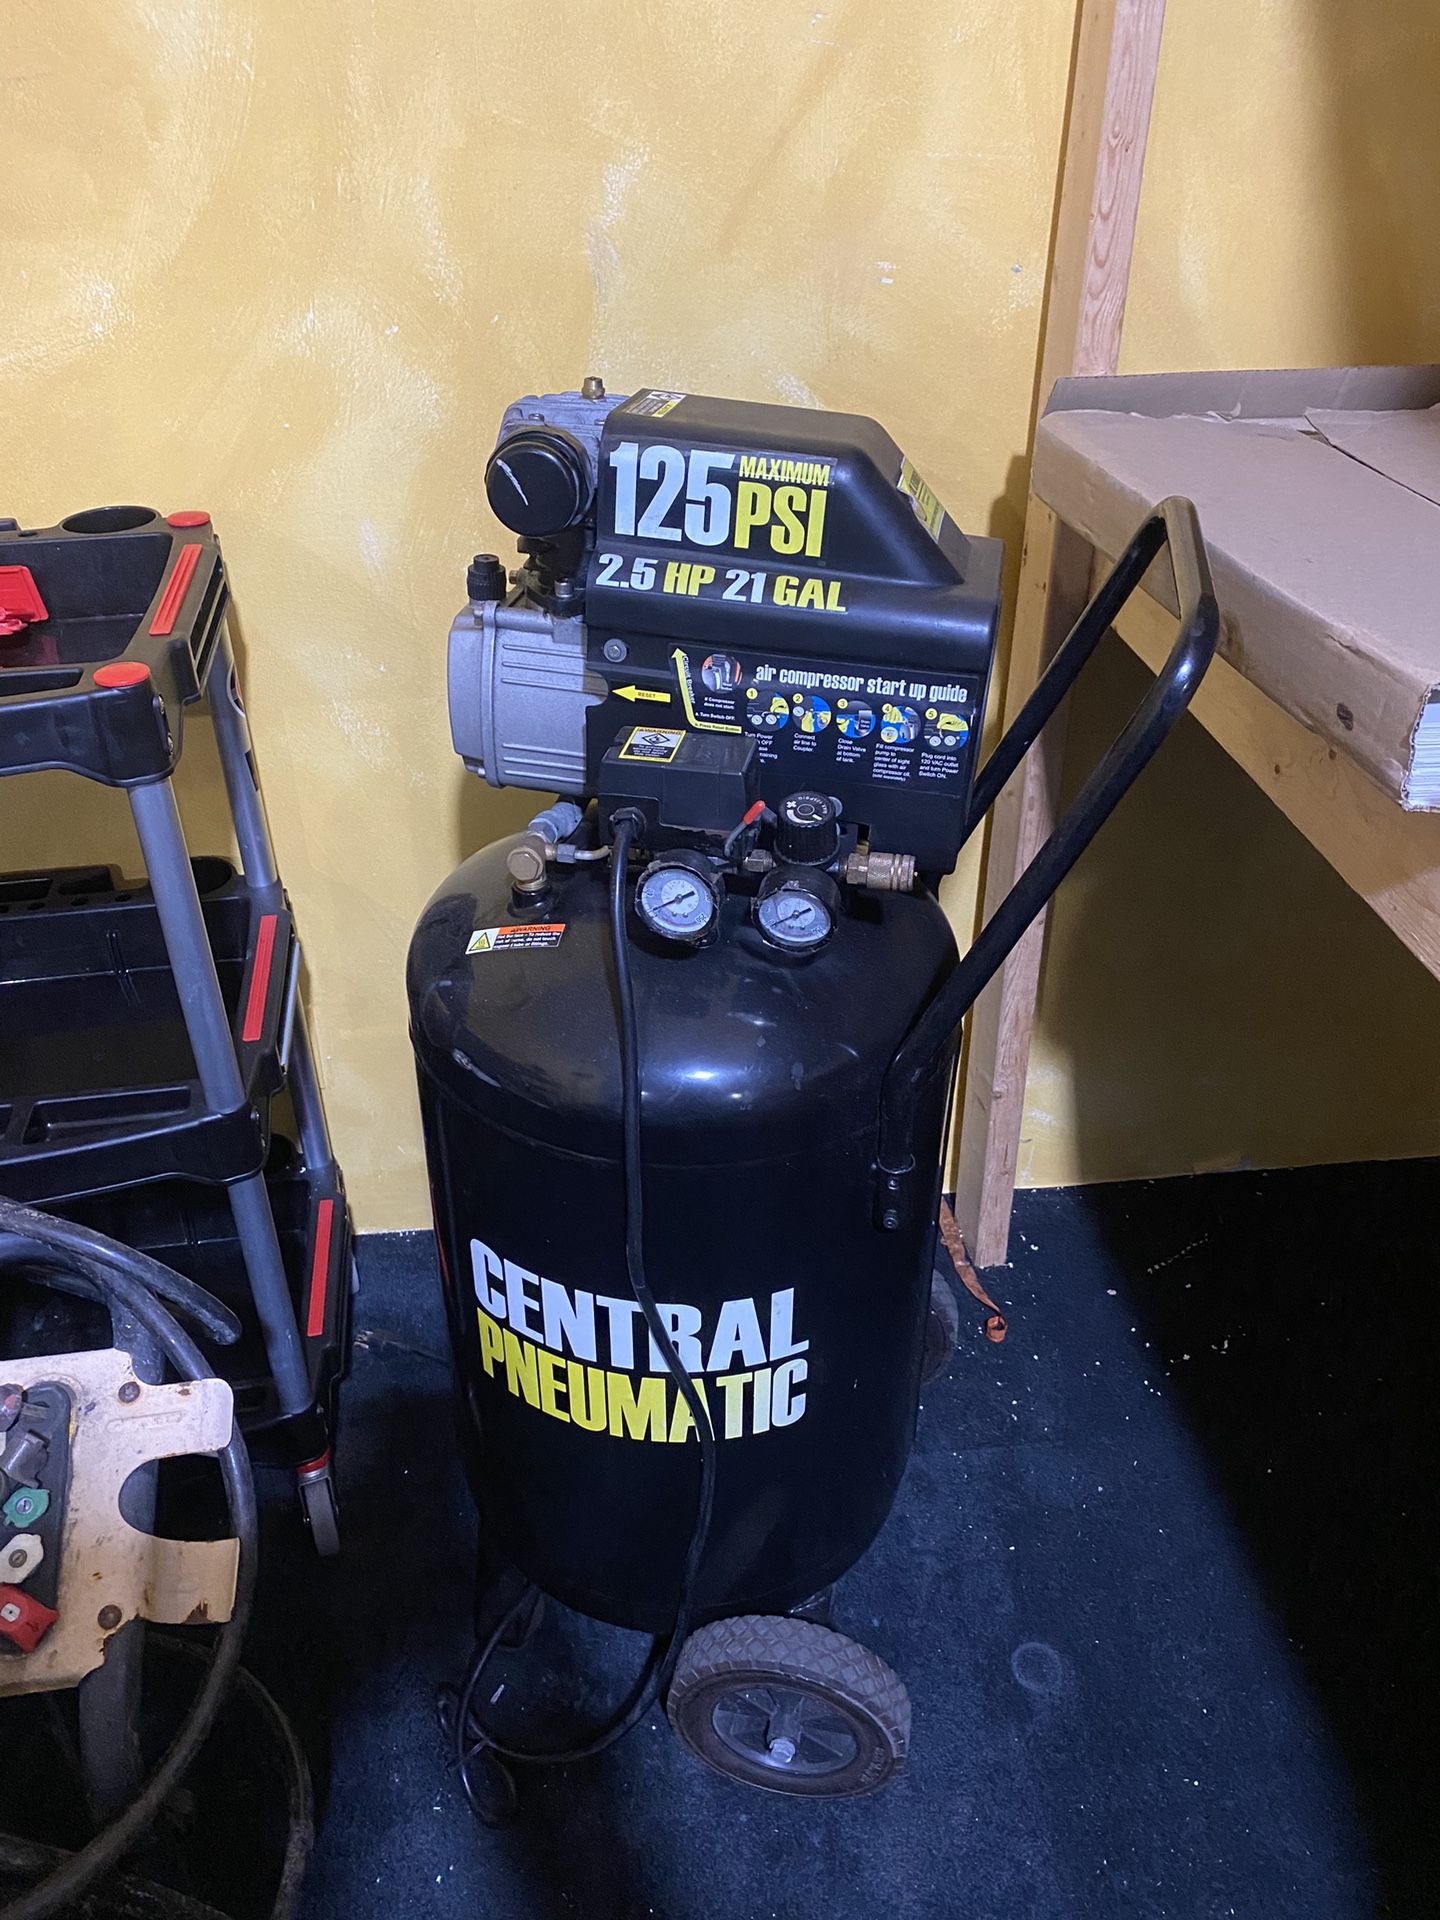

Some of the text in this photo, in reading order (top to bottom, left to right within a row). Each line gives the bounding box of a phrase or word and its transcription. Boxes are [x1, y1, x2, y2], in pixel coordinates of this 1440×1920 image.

[609, 441, 736, 547] 125
[738, 455, 831, 487] MAXIMUM
[733, 480, 828, 558] PSI
[595, 553, 848, 613] 2.5 HP 21 GAL
[756, 664, 968, 703] air compressor start up guide
[469, 1237, 810, 1373] CENTRAL
[476, 1306, 808, 1443] PNEUMATIC
